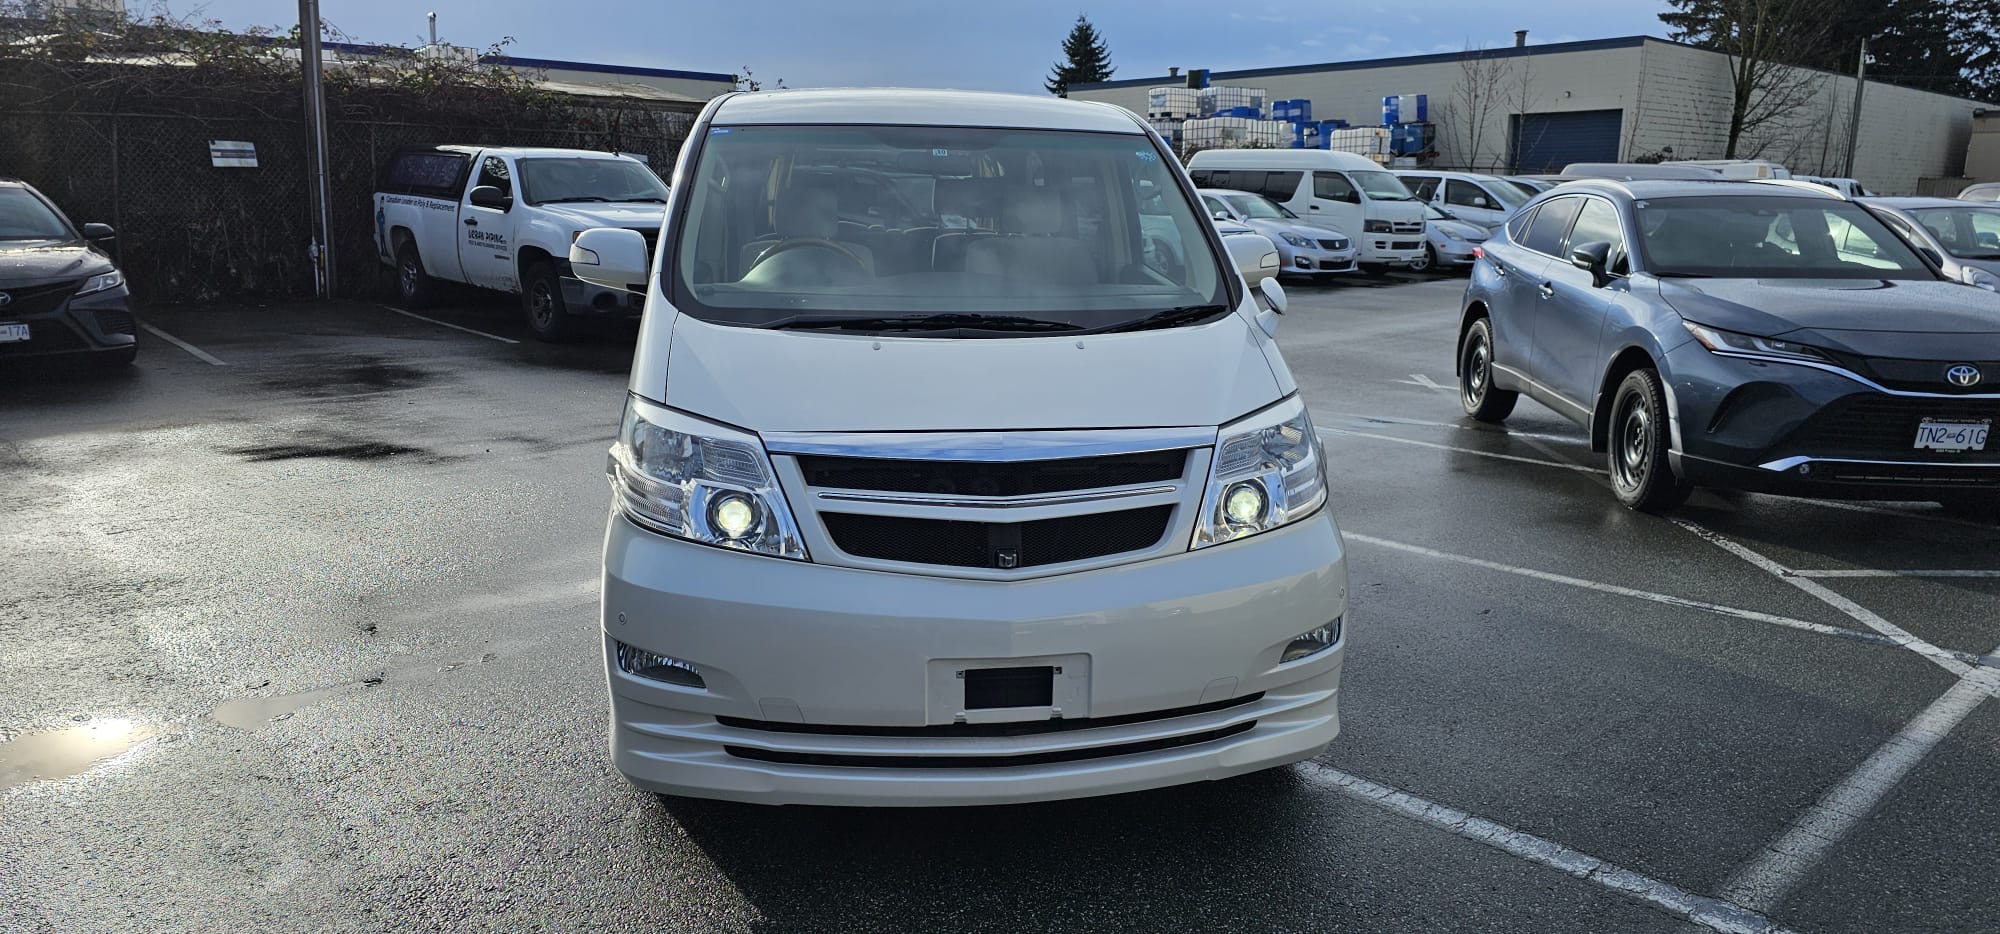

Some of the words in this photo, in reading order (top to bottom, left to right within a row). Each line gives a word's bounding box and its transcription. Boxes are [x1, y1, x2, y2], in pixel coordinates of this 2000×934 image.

[430, 201, 456, 212] Replacement
[468, 229, 485, 241] URBAN
[485, 231, 503, 244] PIPING
